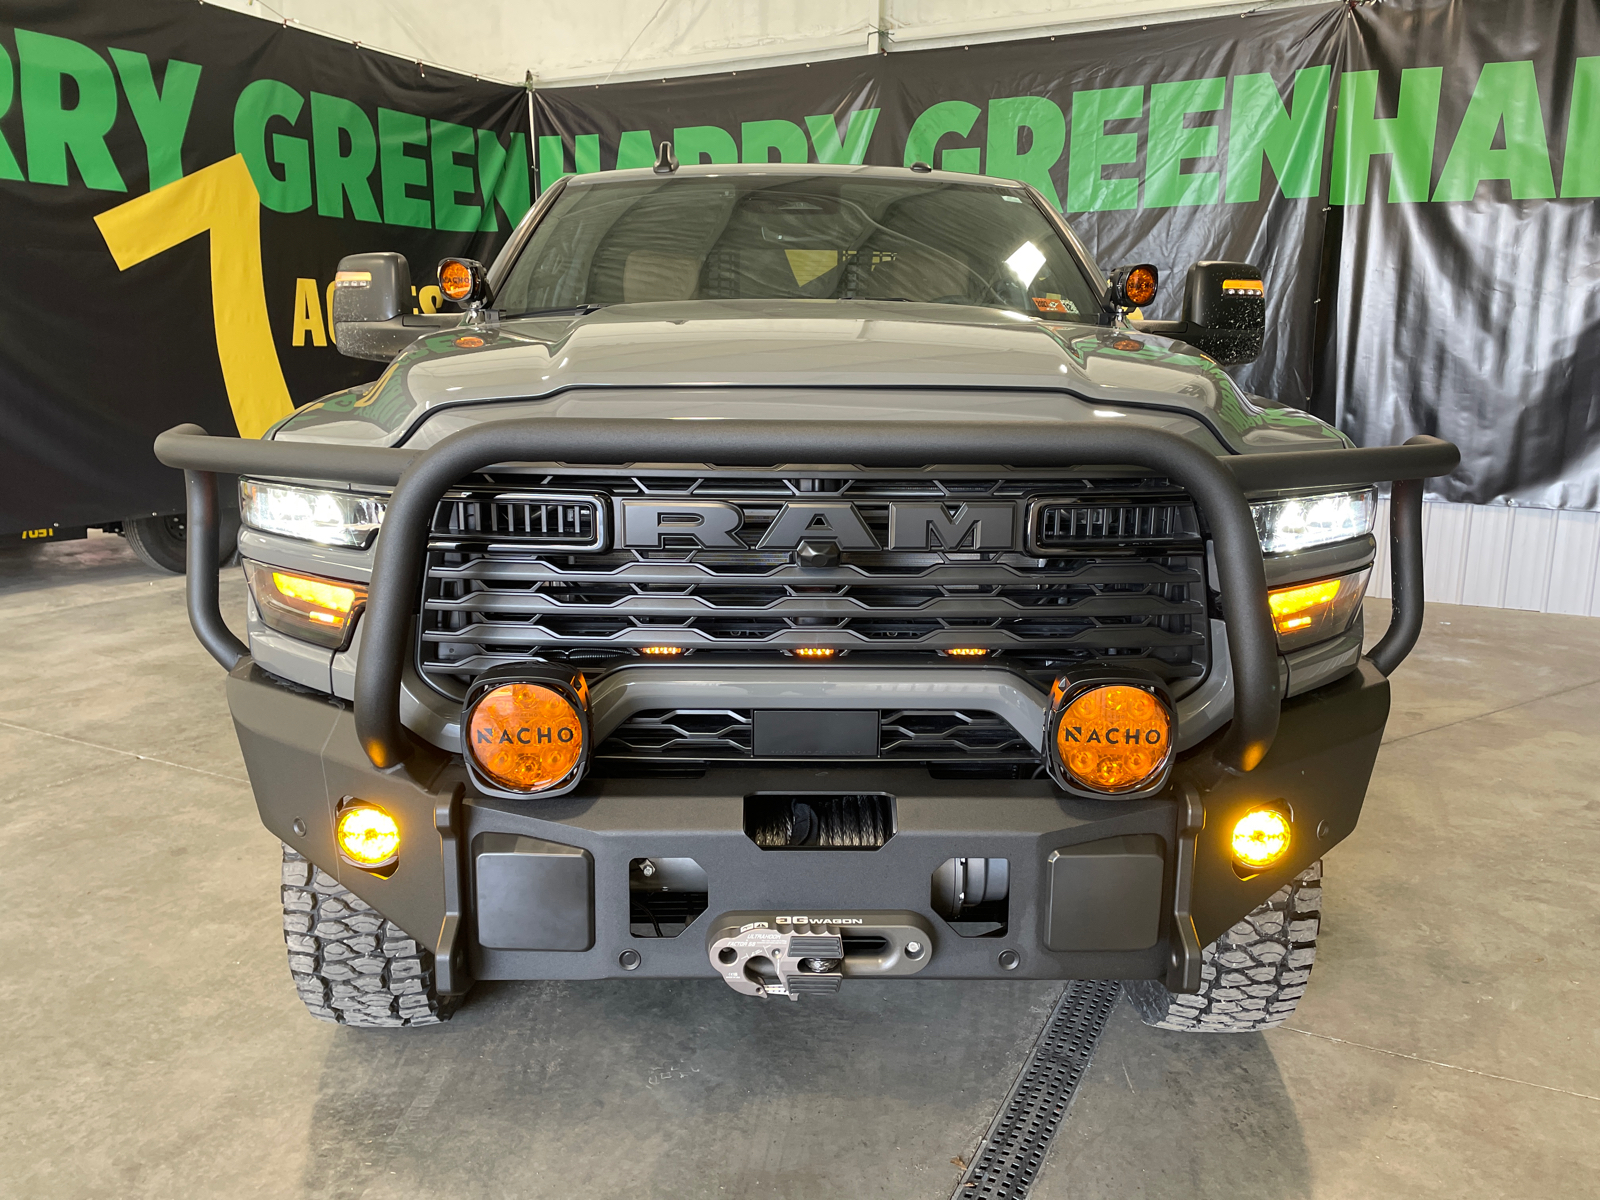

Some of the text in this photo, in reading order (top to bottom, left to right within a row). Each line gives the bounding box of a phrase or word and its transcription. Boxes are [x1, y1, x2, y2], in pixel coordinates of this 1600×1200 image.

[0, 28, 531, 232] RY GREEN
[904, 65, 1331, 213] GREEN
[94, 153, 296, 440] 7
[621, 500, 1018, 552] RAM
[476, 727, 574, 745] NACHO
[1064, 726, 1161, 745] NACHO
